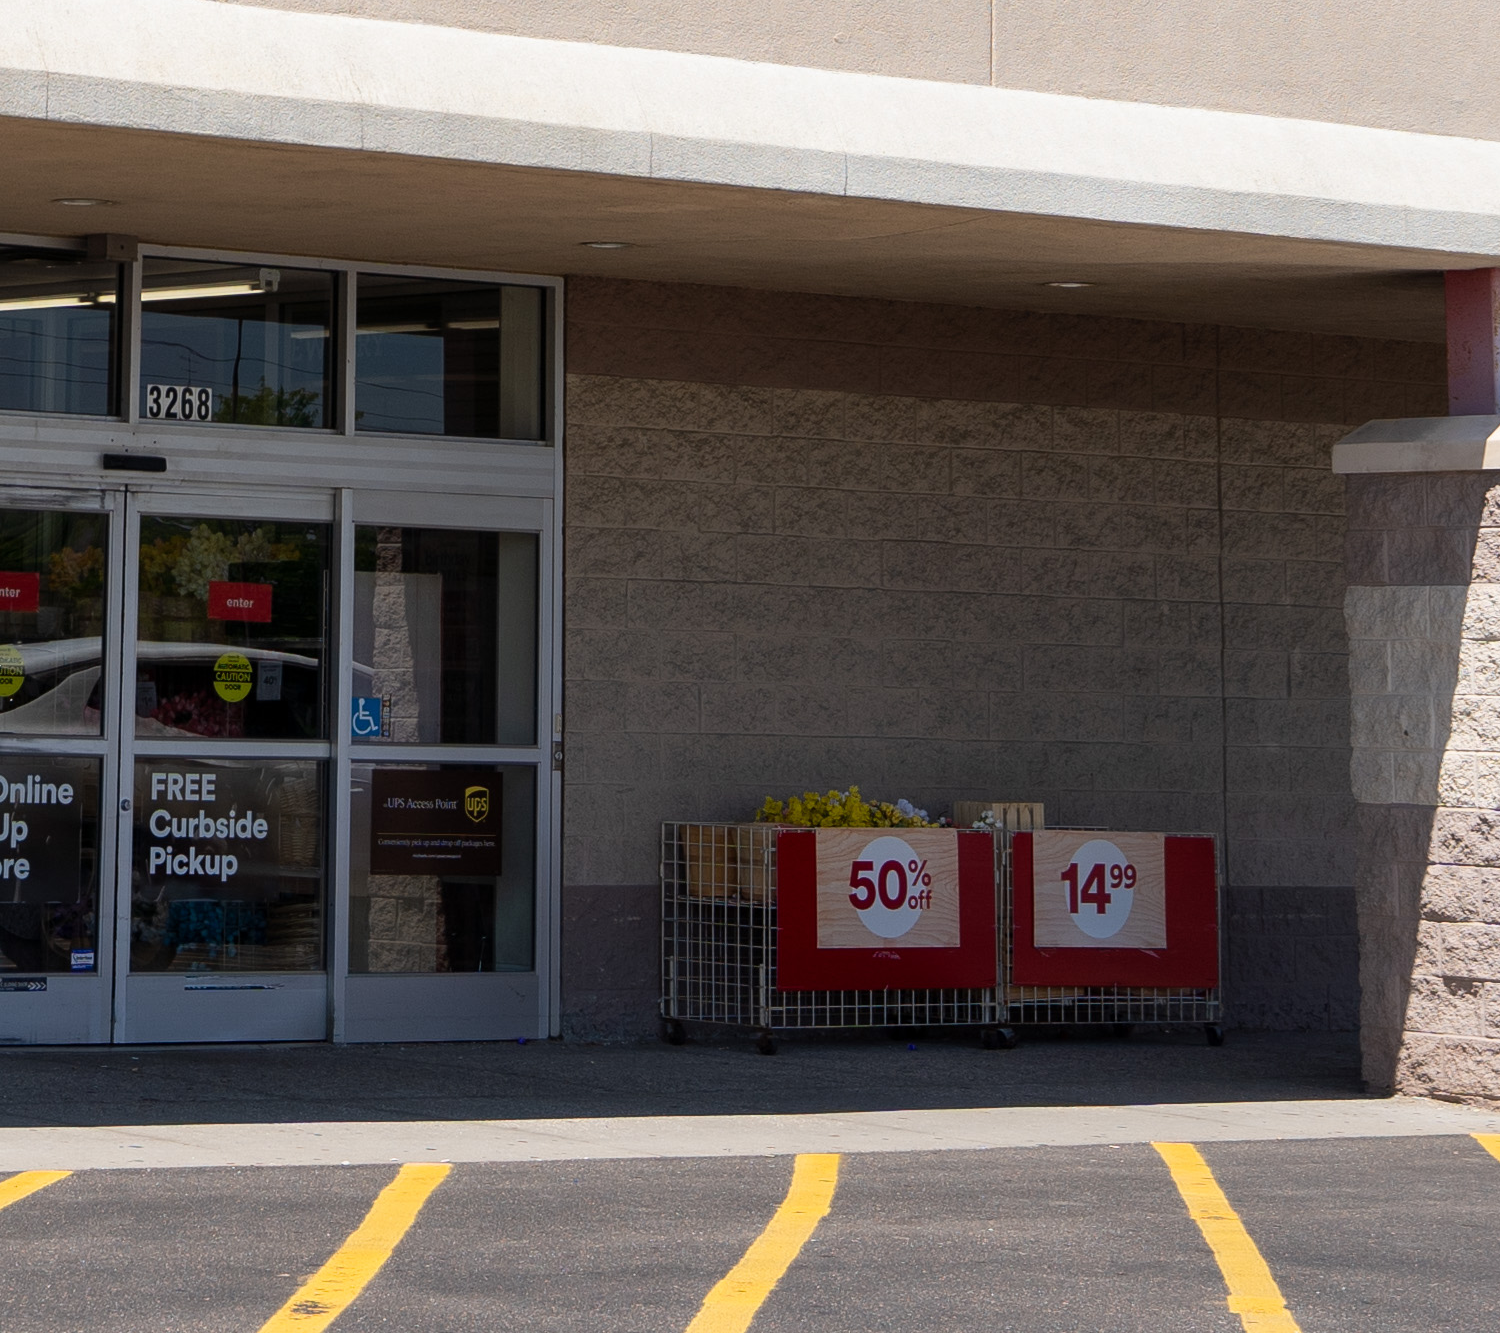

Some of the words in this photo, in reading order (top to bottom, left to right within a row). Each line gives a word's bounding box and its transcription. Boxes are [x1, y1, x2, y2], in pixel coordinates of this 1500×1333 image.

[148, 385, 210, 420] 3268
[226, 597, 255, 608] enter
[215, 672, 251, 682] CAUTION
[151, 772, 217, 801] FREE
[387, 797, 405, 808] UPS
[406, 798, 434, 809] Access
[435, 799, 458, 810] Point
[466, 797, 487, 817] ups
[149, 809, 269, 839] Curbside
[149, 846, 239, 882] Pickup
[908, 889, 933, 910] off
